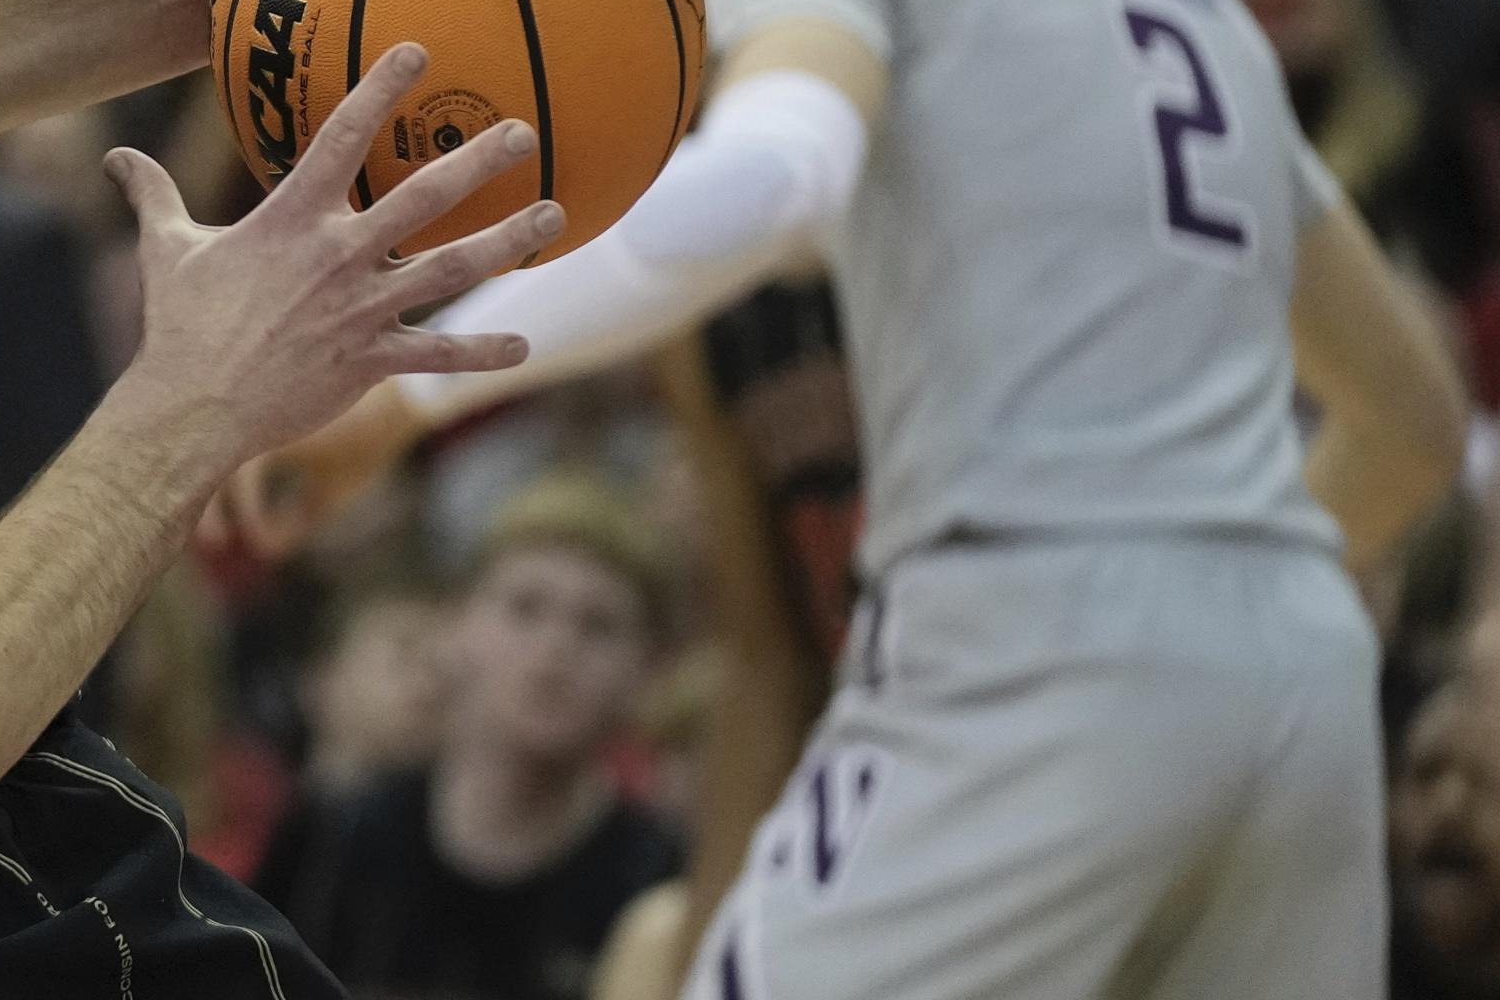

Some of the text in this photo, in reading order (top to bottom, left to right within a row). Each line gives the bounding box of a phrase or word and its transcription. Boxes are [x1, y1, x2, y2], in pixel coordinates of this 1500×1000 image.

[300, 8, 321, 137] GAME BALL
[1119, 3, 1253, 252] 2
